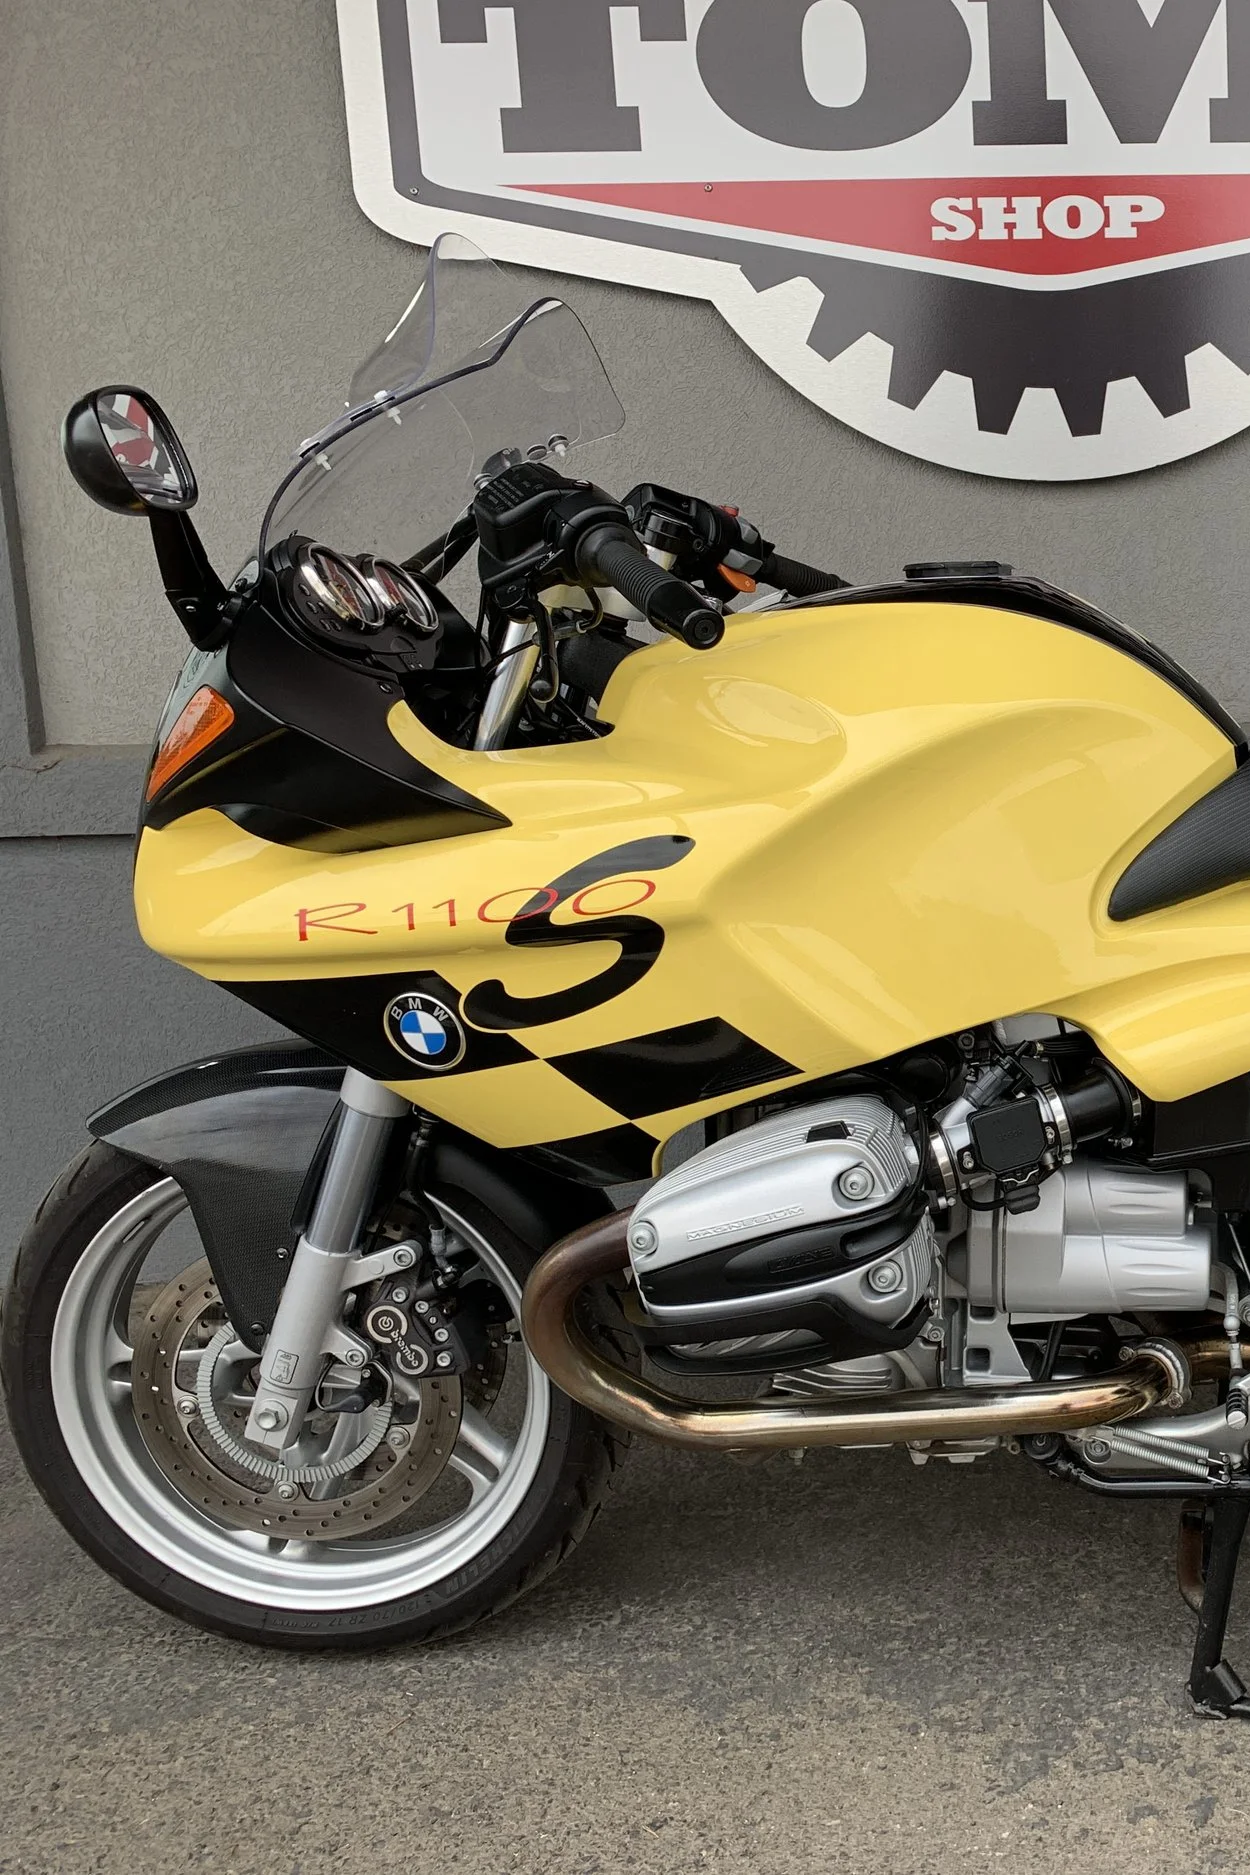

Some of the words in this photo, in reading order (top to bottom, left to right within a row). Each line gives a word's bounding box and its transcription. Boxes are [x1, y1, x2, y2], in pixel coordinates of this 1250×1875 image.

[930, 194, 1165, 241] SHOP
[463, 834, 696, 1030] S
[390, 997, 449, 1022] BMW
[686, 1206, 806, 1241] MAGNESIUM
[390, 1328, 419, 1367] brembo
[444, 1507, 534, 1596] MICHELIN
[327, 1616, 344, 1627] 17
[348, 1613, 369, 1626] ZR
[372, 1600, 420, 1622] 120/70
